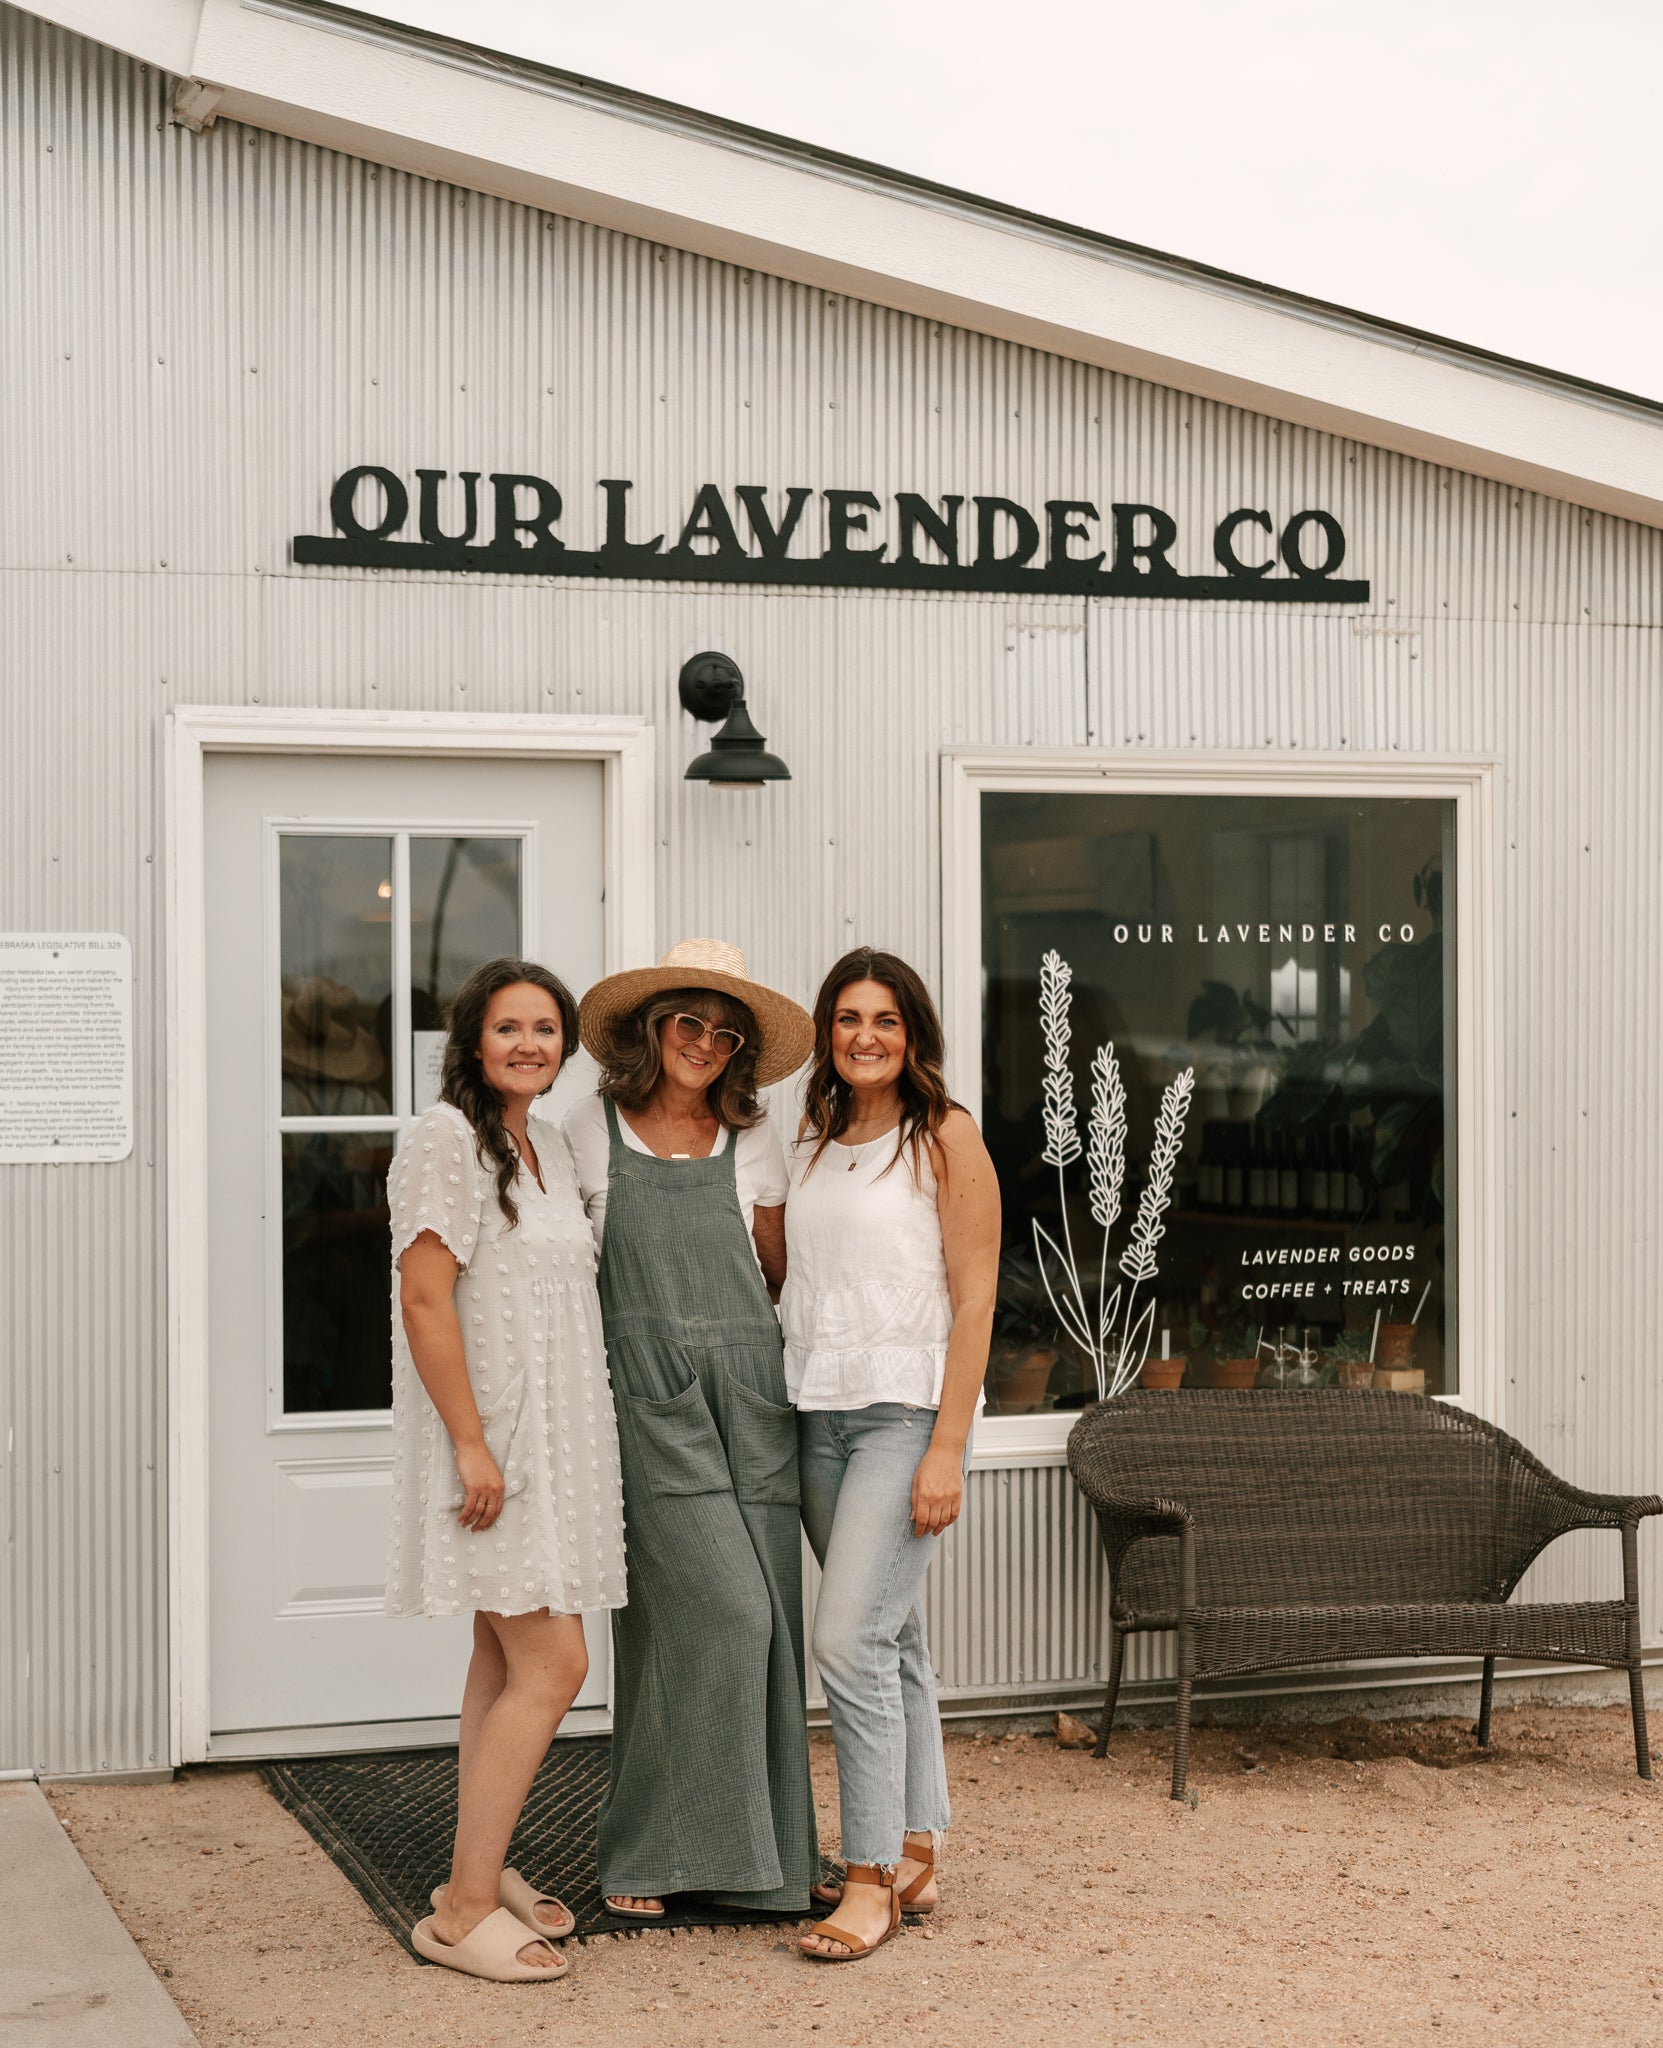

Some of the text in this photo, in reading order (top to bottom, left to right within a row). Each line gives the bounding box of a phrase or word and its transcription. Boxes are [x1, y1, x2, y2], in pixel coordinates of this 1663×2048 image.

[330, 466, 1346, 581] OUR LAVENDER CO
[1113, 924, 1414, 943] OUR LAVENDER CO
[37, 941, 86, 949] LEGISLATIVE
[88, 941, 105, 949] BILL
[107, 941, 121, 949] 329
[1241, 1245, 1416, 1266] LAVENDER GOODS
[1242, 1279, 1410, 1300] COFFEE + TREATS
